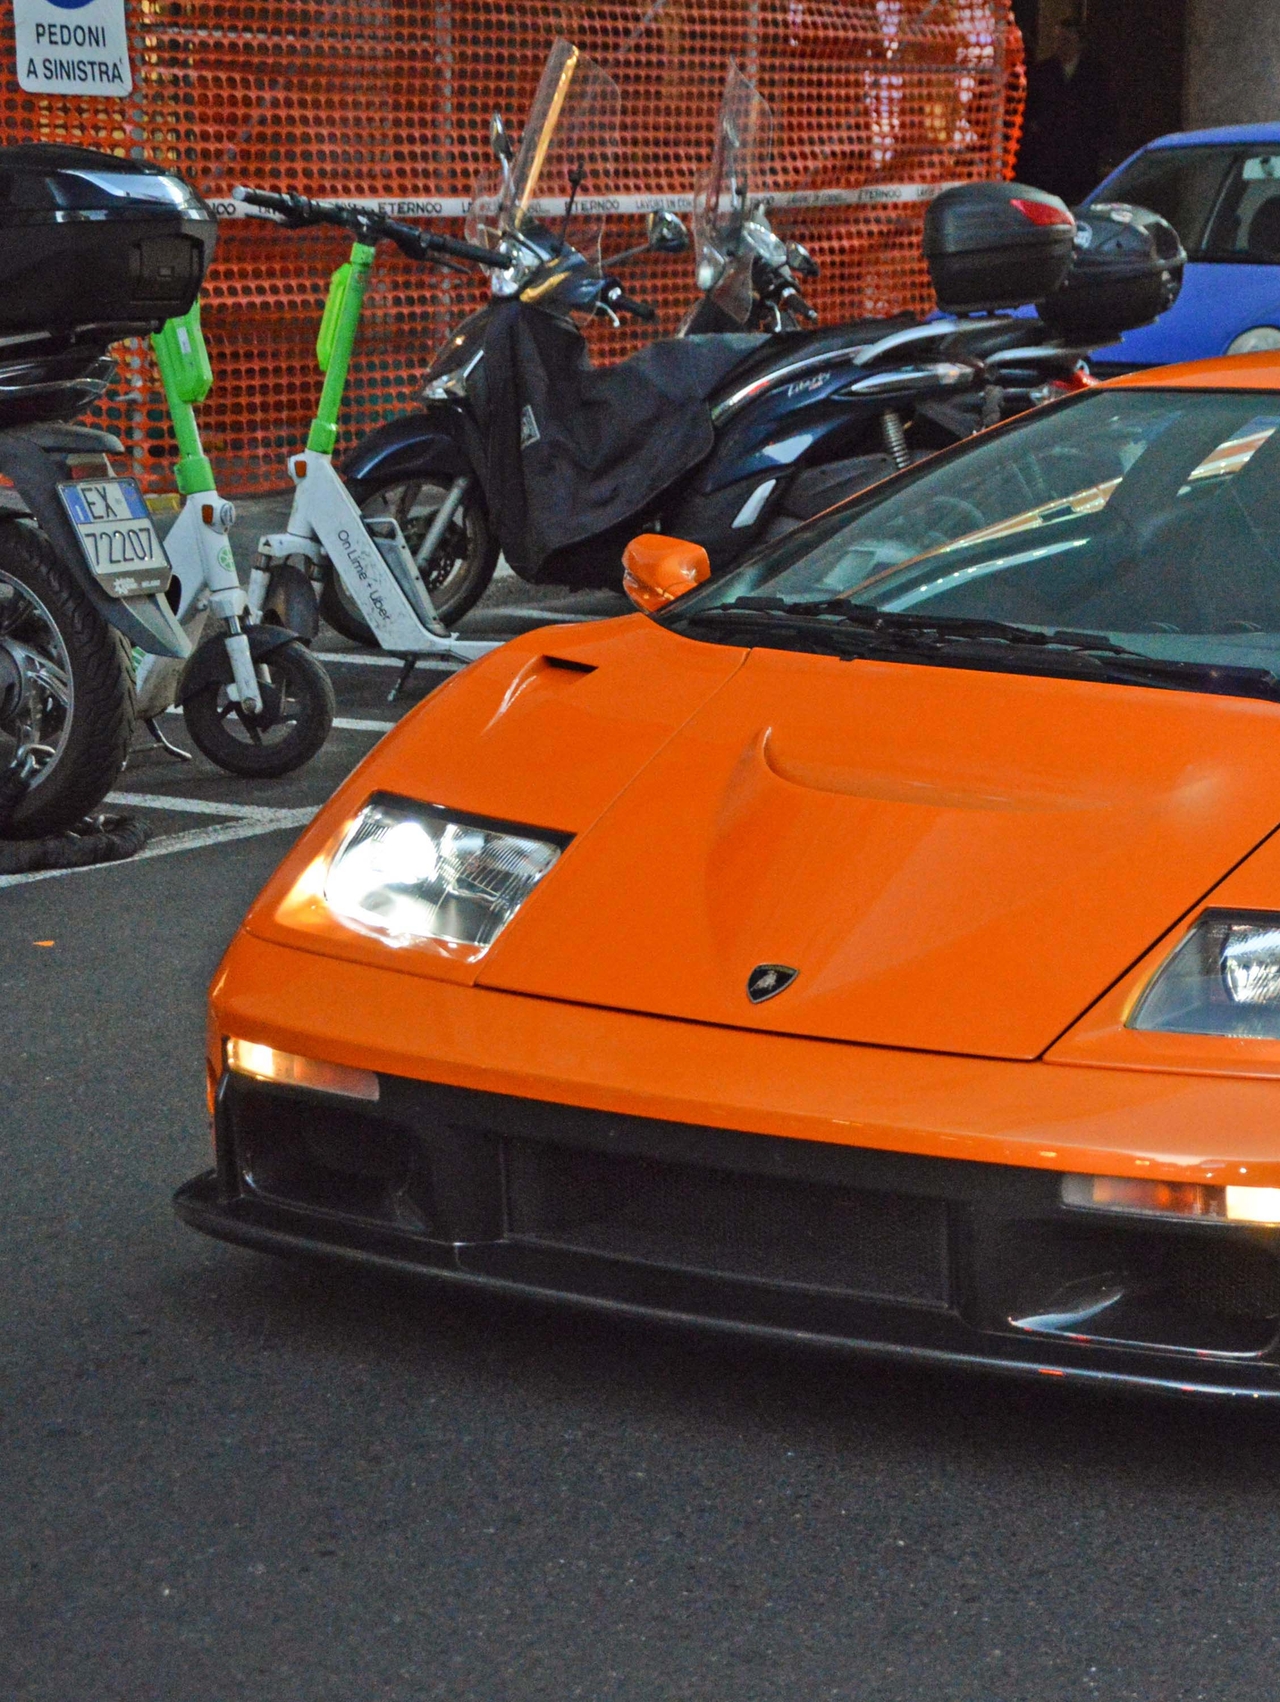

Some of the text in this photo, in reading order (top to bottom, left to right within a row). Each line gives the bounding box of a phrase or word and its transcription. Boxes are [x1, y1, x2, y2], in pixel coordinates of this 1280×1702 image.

[35, 23, 106, 47] PEDONI
[26, 57, 124, 84] A SINISTRA
[81, 486, 118, 520] EX
[84, 527, 155, 566] 72207
[337, 529, 352, 551] On
[347, 549, 368, 581] Lime
[369, 589, 391, 621] Uber
